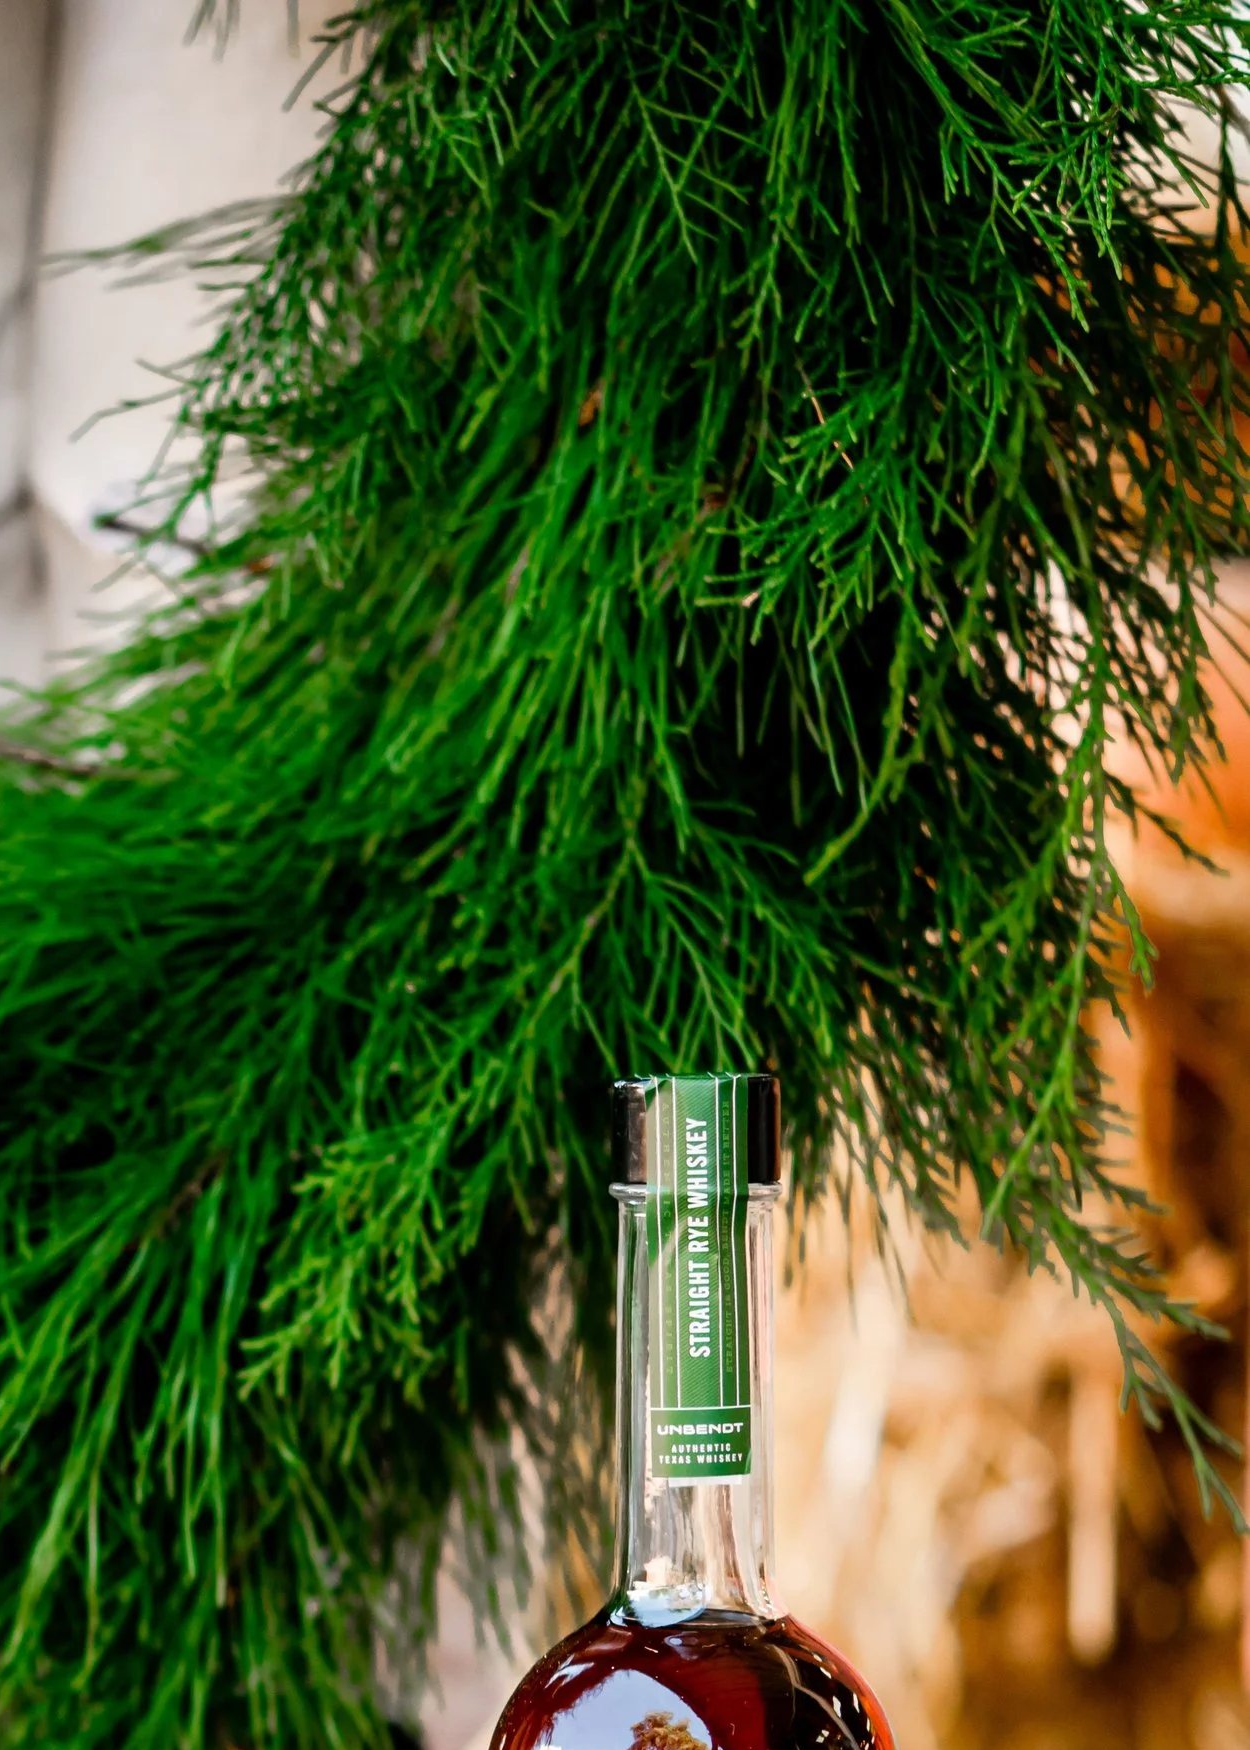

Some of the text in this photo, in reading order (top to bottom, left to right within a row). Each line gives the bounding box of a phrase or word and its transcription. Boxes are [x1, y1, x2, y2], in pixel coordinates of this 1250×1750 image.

[686, 1118, 710, 1358] STRAIGHT RYE WHISKEY
[657, 1423, 743, 1435] UNBENDT
[671, 1443, 731, 1453] AUTHENTIC
[659, 1453, 743, 1465] TEXAS WHISKEY
